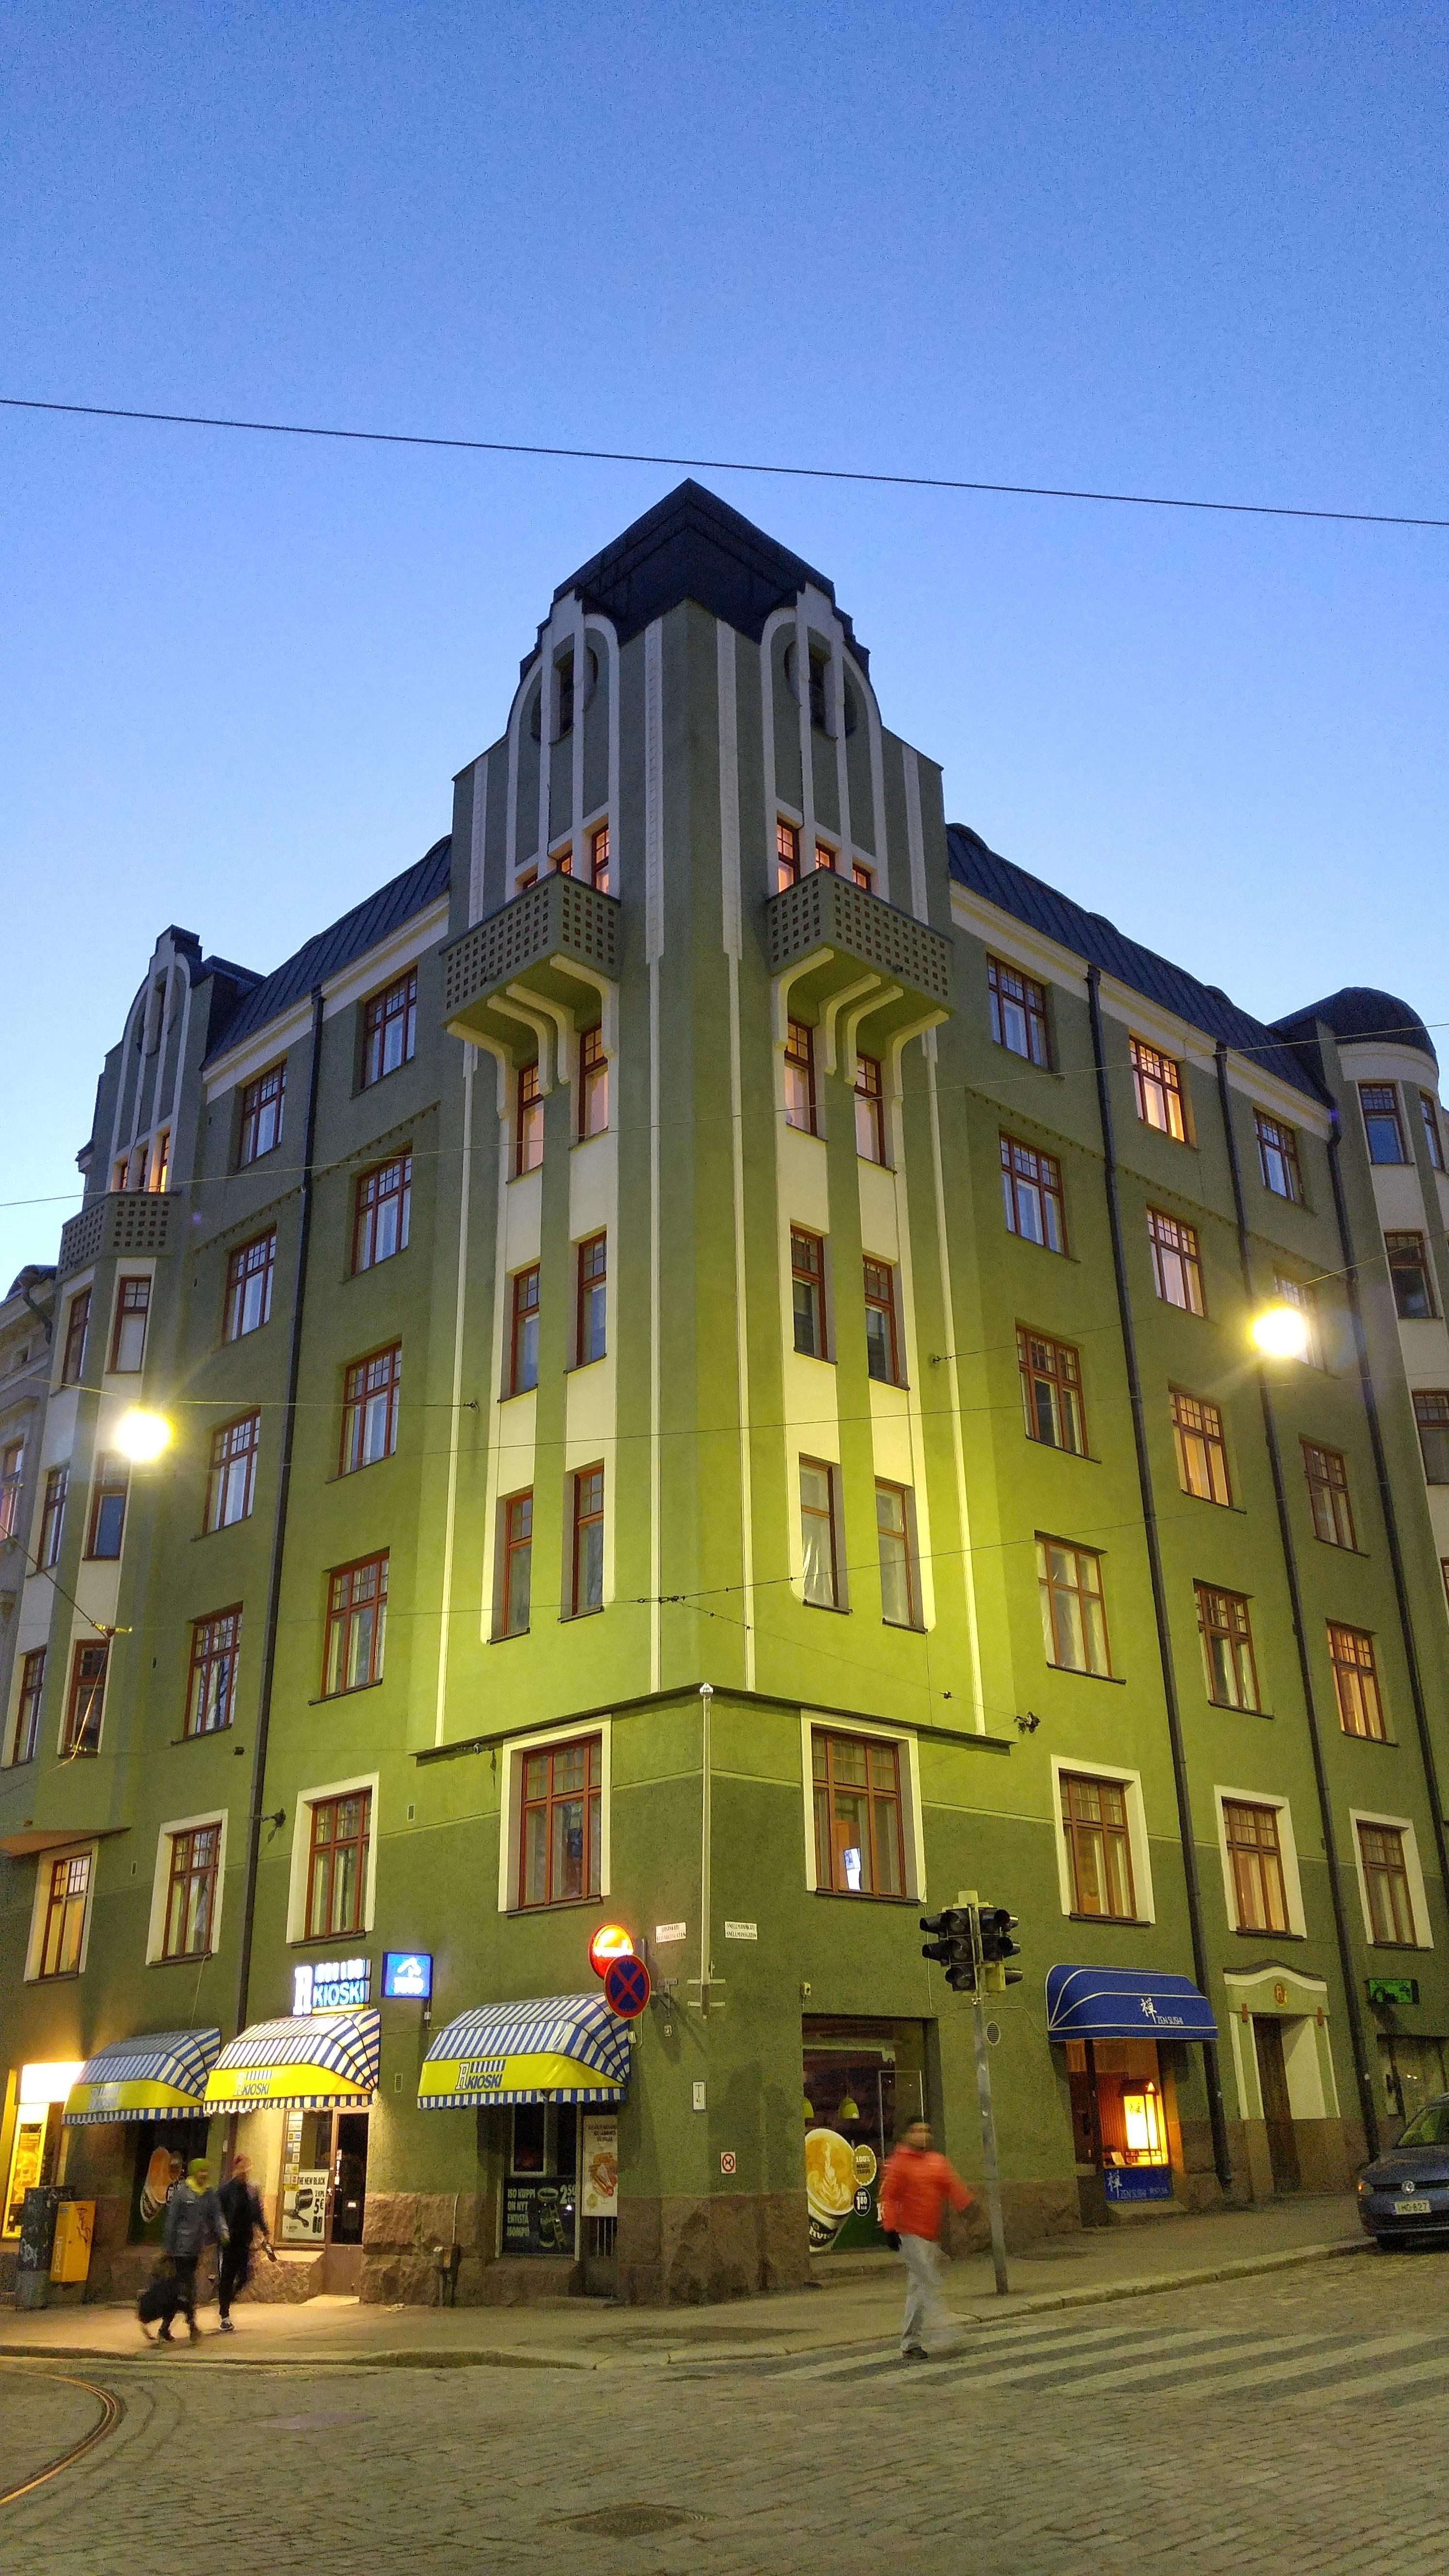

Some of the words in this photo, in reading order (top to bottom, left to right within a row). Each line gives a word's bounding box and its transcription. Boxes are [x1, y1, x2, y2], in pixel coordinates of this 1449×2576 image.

[313, 1980, 365, 2007] KIOSKI
[1156, 2016, 1168, 2024] ZEN
[1167, 2016, 1184, 2025] SUSHI
[466, 2073, 502, 2090] KIOSKI
[242, 2082, 270, 2095] KIOSKI
[313, 2177, 325, 2185] BLACK
[508, 2188, 517, 2198] ISO
[518, 2188, 535, 2198] KUPPI
[516, 2201, 528, 2211] NYT
